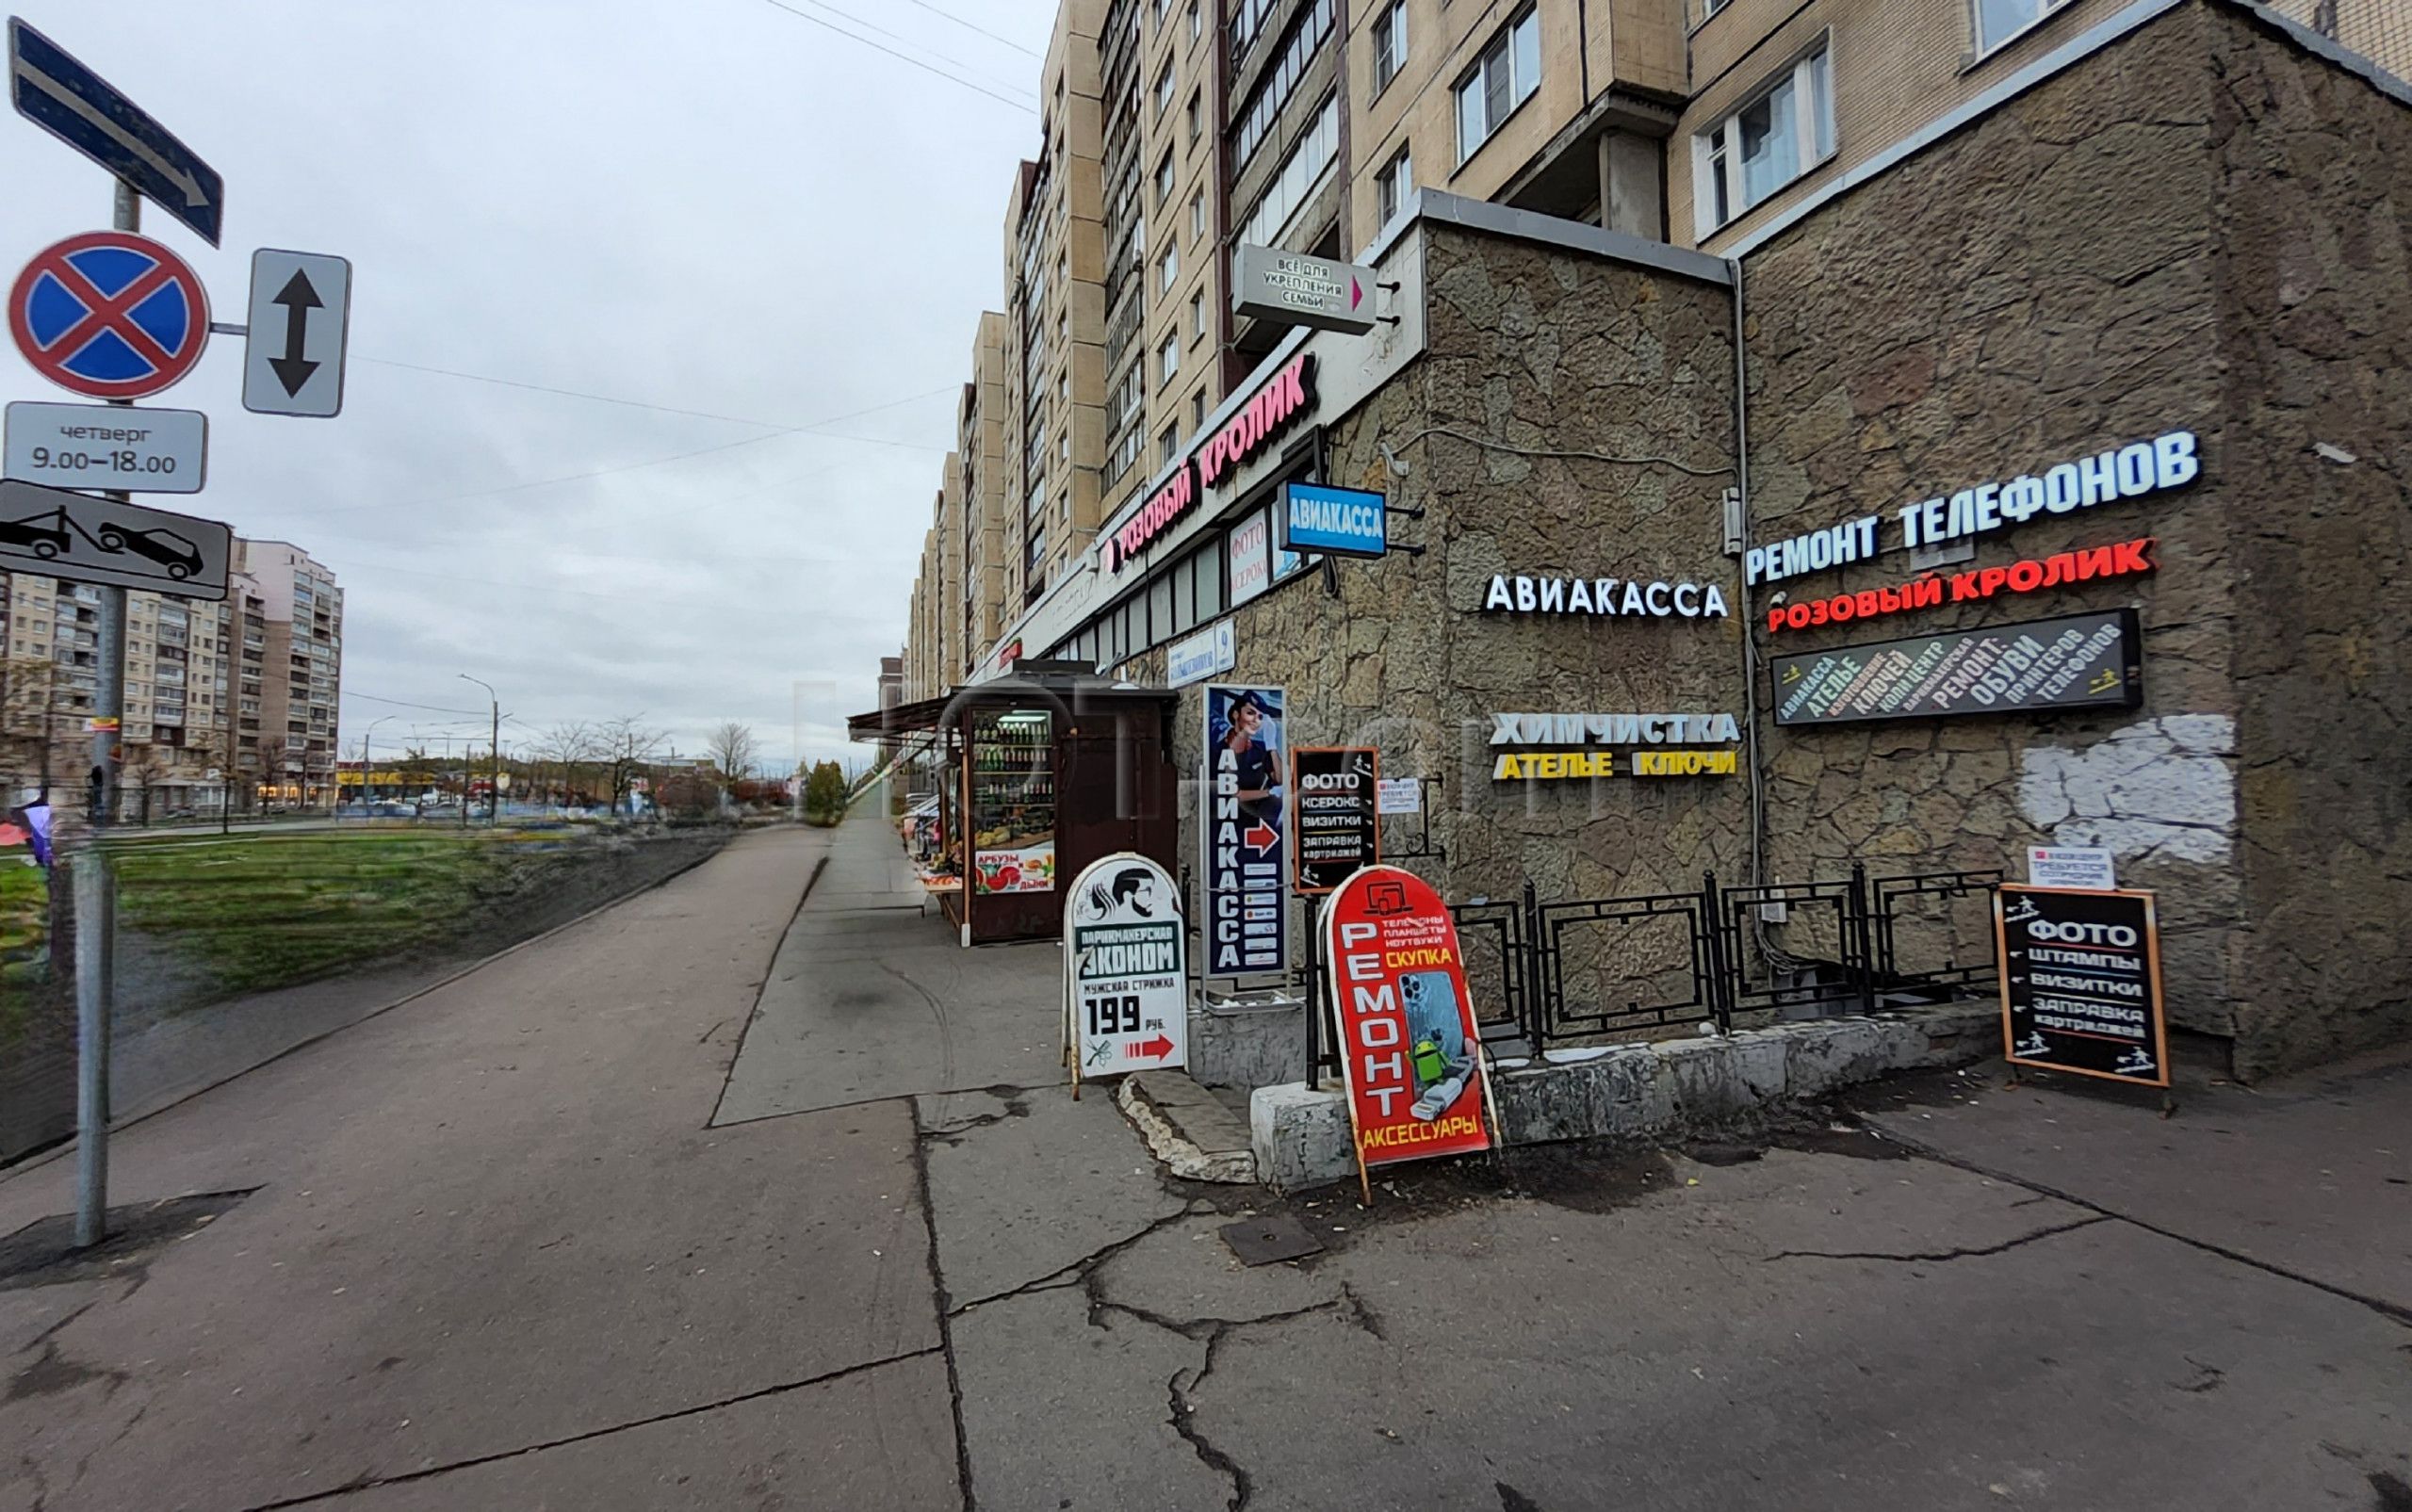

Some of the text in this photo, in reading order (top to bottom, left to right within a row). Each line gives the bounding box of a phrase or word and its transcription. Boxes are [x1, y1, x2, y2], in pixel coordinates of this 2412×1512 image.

[1277, 258, 1329, 278] ВСЁ ДЛЯ
[1263, 271, 1343, 296] УКРЕПЛЕНИЯ
[1282, 291, 1324, 308] СЕМЬИ
[59, 426, 153, 446] четверг
[1119, 354, 1306, 559] РОЗОВЫЙ КРОЛИК
[1289, 496, 1383, 538] АВИАКАССА
[1747, 430, 2200, 586] РЕМОНТ ТЕЛЕФОНОВ
[1231, 521, 1265, 560] ФОТО
[1485, 574, 1728, 618] АВИАКАССА
[1768, 537, 2159, 632] РОЗОВЫЙ КРОЛИК
[1901, 637, 1976, 712] ПАРИКМАХЕРСКАЯ
[1970, 634, 2045, 706] ОБУВИ
[2005, 629, 2085, 704] ПРИНТЕРОВ
[2035, 623, 2122, 701] ТЕЛЕФОНОВ
[1780, 657, 1836, 720] АВИАКАССА
[1806, 656, 1862, 718] АТЕЛЬЕ
[1828, 652, 1887, 717] ИЗГОТОВЛЕНИЕ
[1851, 649, 1913, 715] КЛЮЧЕЙ
[1878, 642, 1945, 713] КОПИ ЦЕНТР
[1489, 712, 1741, 744] ХИМЧИСТКА
[1492, 751, 1736, 780] АТЕЛЬЕ КЛЮЧИ
[1301, 773, 1360, 789] ФОТО
[1302, 796, 1361, 808] КСЕРОКС
[1303, 816, 1361, 827] ВИЗИТКИ
[1303, 836, 1361, 847] ЗАПРАВКА
[1303, 848, 1361, 859] картриджей
[978, 854, 1019, 864] АРБУЗЫ
[1216, 748, 1241, 967] АВИАКАССА
[1019, 881, 1049, 890] ДЫНИ
[1081, 926, 1173, 945] ПАРИКМАХЕРСКАЯ
[1383, 925, 1447, 937] ПЛАНШЕТЫ
[1385, 935, 1442, 948] НОУТБУКИ
[2028, 919, 2137, 947] ФОТО
[1082, 942, 1175, 976] ЭКОНОМ
[1386, 948, 1453, 968] СКУПКА
[2029, 948, 2142, 971] ШТАМПЫ
[1084, 977, 1175, 995] МУЖСКАЯ СТРИЖКА
[2029, 972, 2143, 997] ВИЗИТКИ
[1085, 995, 1140, 1035] 199
[1341, 921, 1405, 1117] РЕМОНТ
[2032, 997, 2145, 1023] ЗАПРАВКА
[2034, 1014, 2146, 1038] картриджей
[1363, 1114, 1478, 1149] АКСЕССУАРЫ
